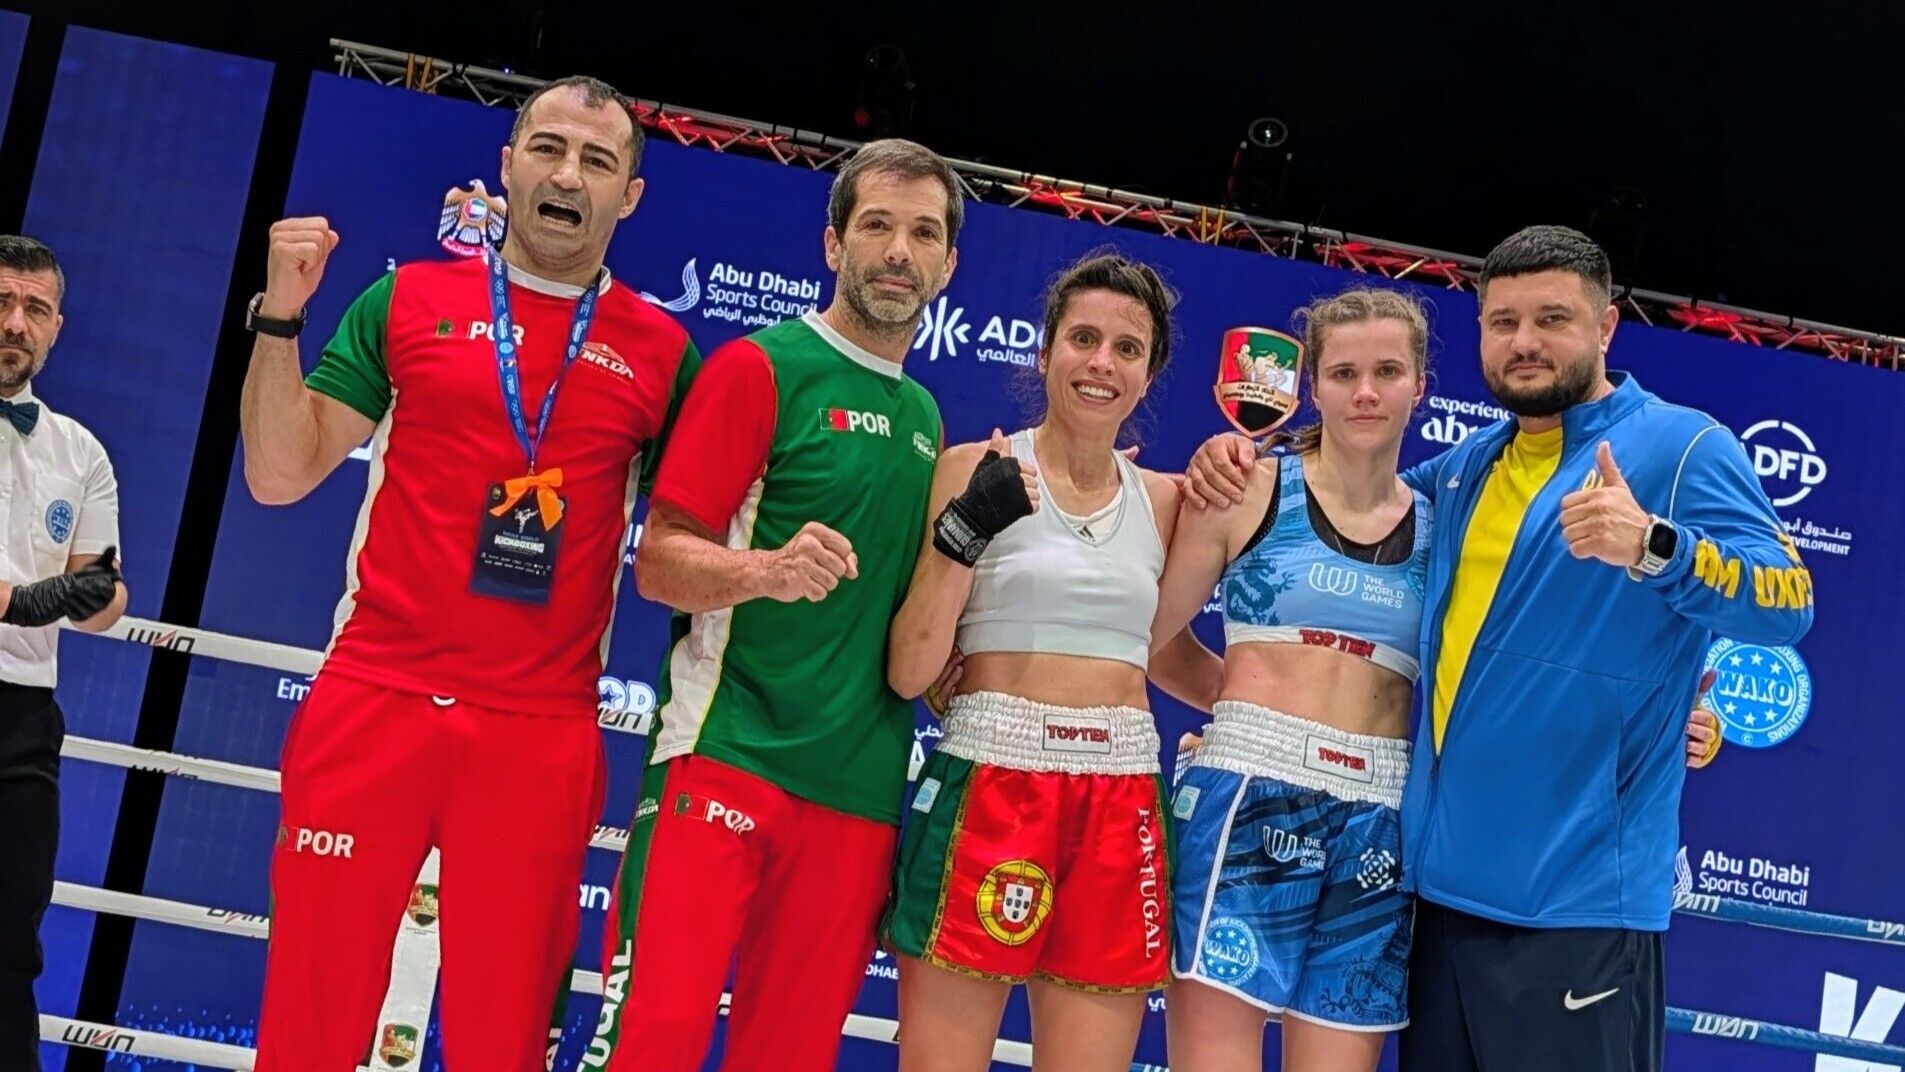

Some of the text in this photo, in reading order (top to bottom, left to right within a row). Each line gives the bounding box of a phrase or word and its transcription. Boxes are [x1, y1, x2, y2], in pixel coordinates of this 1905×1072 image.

[705, 283, 758, 308] Sports
[709, 262, 821, 300] Abu Dhabi
[847, 410, 891, 437] POR
[1421, 414, 1478, 445] ab
[1741, 443, 1827, 485] DFD
[1362, 583, 1404, 600] WORLD
[1364, 574, 1384, 586] THE
[1361, 591, 1402, 609] GAMES
[1299, 629, 1337, 648] TOP
[1715, 671, 1793, 706] WAKO
[296, 828, 354, 858] POR
[1303, 836, 1321, 849] THE
[1137, 807, 1161, 959] PORTUGAL
[1701, 849, 1810, 887] Abu Dhabi
[1698, 871, 1808, 906] Sports Council
